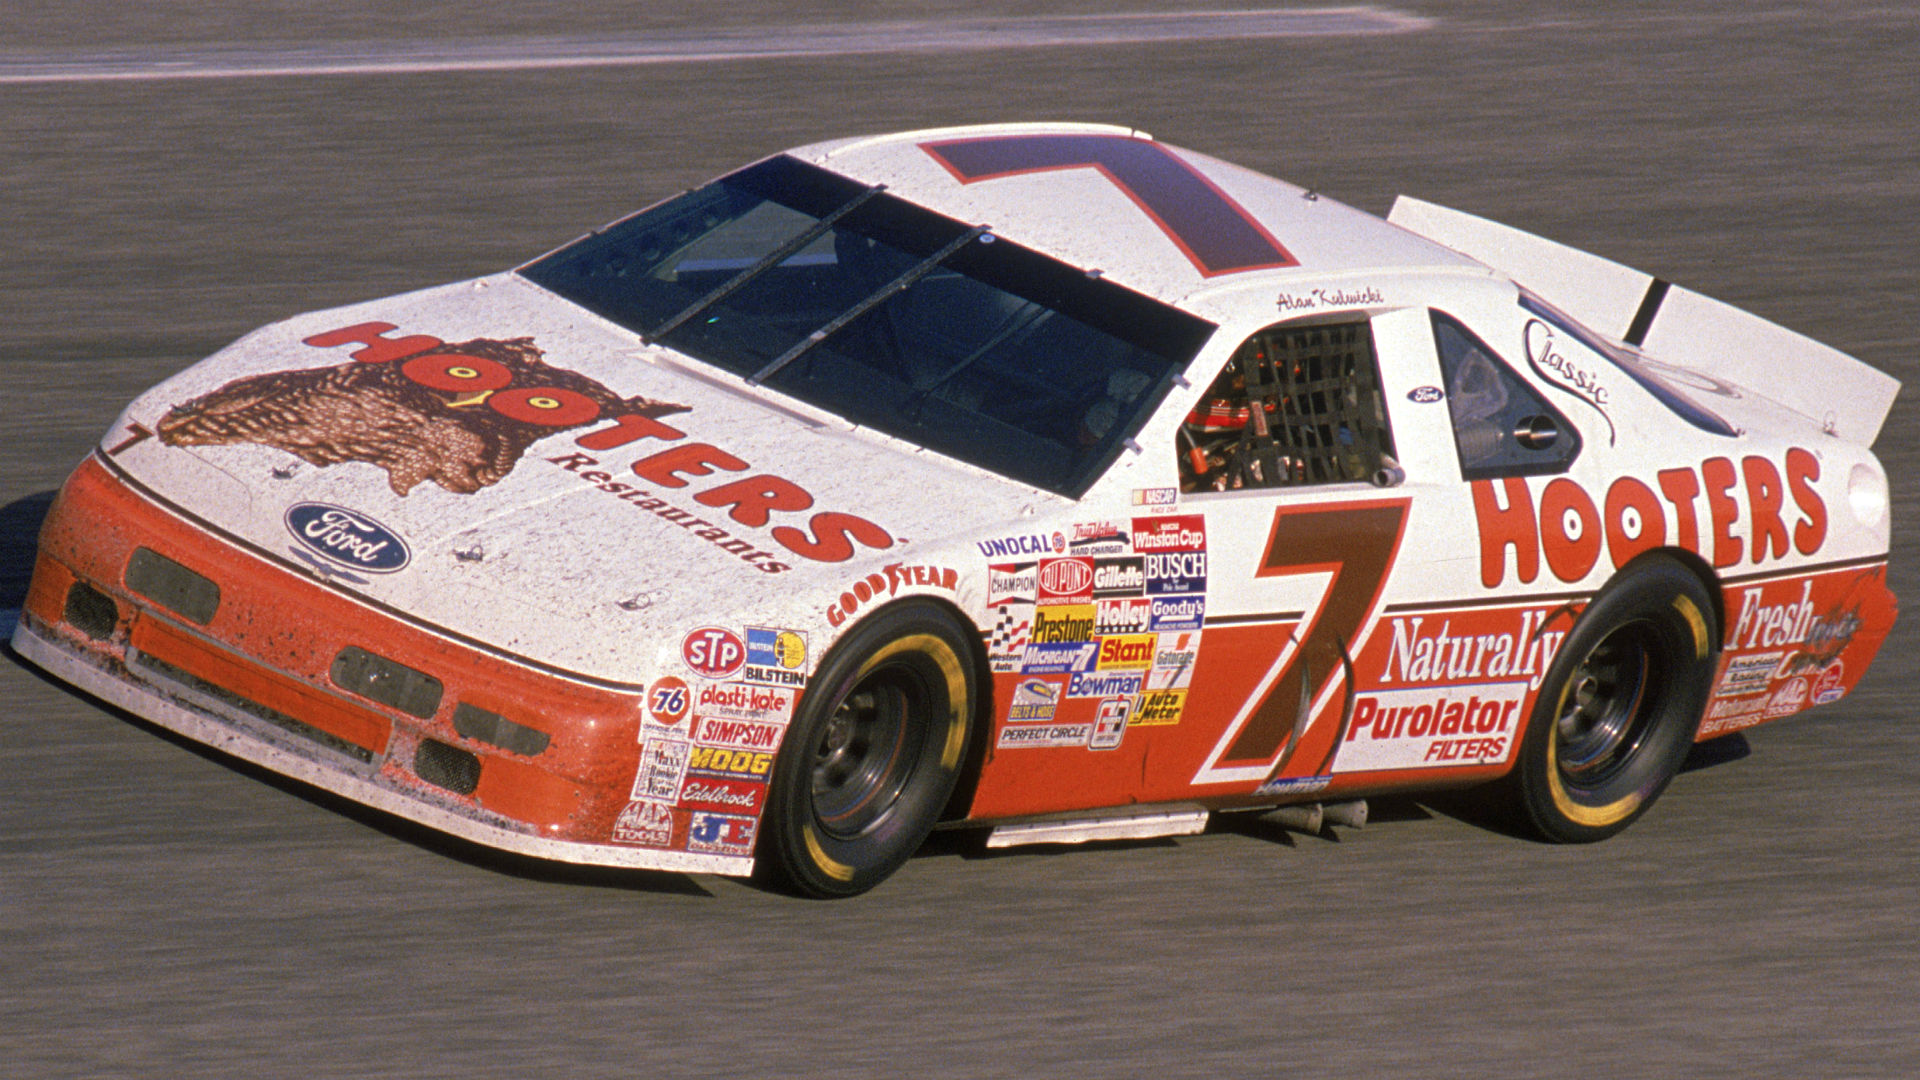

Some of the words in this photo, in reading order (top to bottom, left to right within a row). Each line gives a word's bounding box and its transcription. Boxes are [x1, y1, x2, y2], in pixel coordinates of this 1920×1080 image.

[915, 135, 1301, 278] 7
[1276, 293, 1315, 312] Alan
[1312, 286, 1384, 306] Kulwicki
[1414, 388, 1440, 402] Ford
[1522, 318, 1616, 447] Classic
[107, 423, 155, 456] 7
[301, 321, 893, 562] HOOTERS
[1146, 488, 1175, 504] NASCAR
[546, 453, 793, 575] Restaurants
[1471, 446, 1828, 588] HOOTERS
[304, 511, 388, 562] Ford
[976, 534, 1052, 557] UNOCAL
[1134, 531, 1178, 549] Winston
[1180, 529, 1204, 549] Cup
[1094, 566, 1143, 588] Gillette
[1147, 553, 1206, 579] BUSCH
[826, 562, 958, 627] GOODYEAR
[992, 577, 1035, 594] CHAMPION
[1096, 600, 1150, 632] Holley
[1152, 599, 1203, 622] Goody's
[1724, 580, 1814, 650] Fresh
[1033, 612, 1094, 643] Prestone
[690, 631, 738, 673] STP
[1101, 637, 1154, 662] Stant
[1190, 497, 1413, 785] 7
[1380, 611, 1565, 690] Naturally
[1023, 646, 1075, 665] MICHIGAN
[746, 667, 805, 685] BILSTEIN
[1067, 672, 1142, 696] Bowman
[652, 687, 688, 715] 76
[700, 684, 785, 711] plasti-kote
[1148, 692, 1178, 706] Auto
[1143, 706, 1180, 719] Meter
[1346, 697, 1518, 742] Purolator
[702, 720, 778, 747] SIMPSON
[1002, 728, 1050, 740] PERFECT
[1050, 727, 1088, 738] CIRCLE
[691, 747, 773, 775] MOOG
[1424, 737, 1508, 762] FILTERS
[682, 783, 757, 807] Edelbrock
[616, 828, 667, 842] TOOLS
